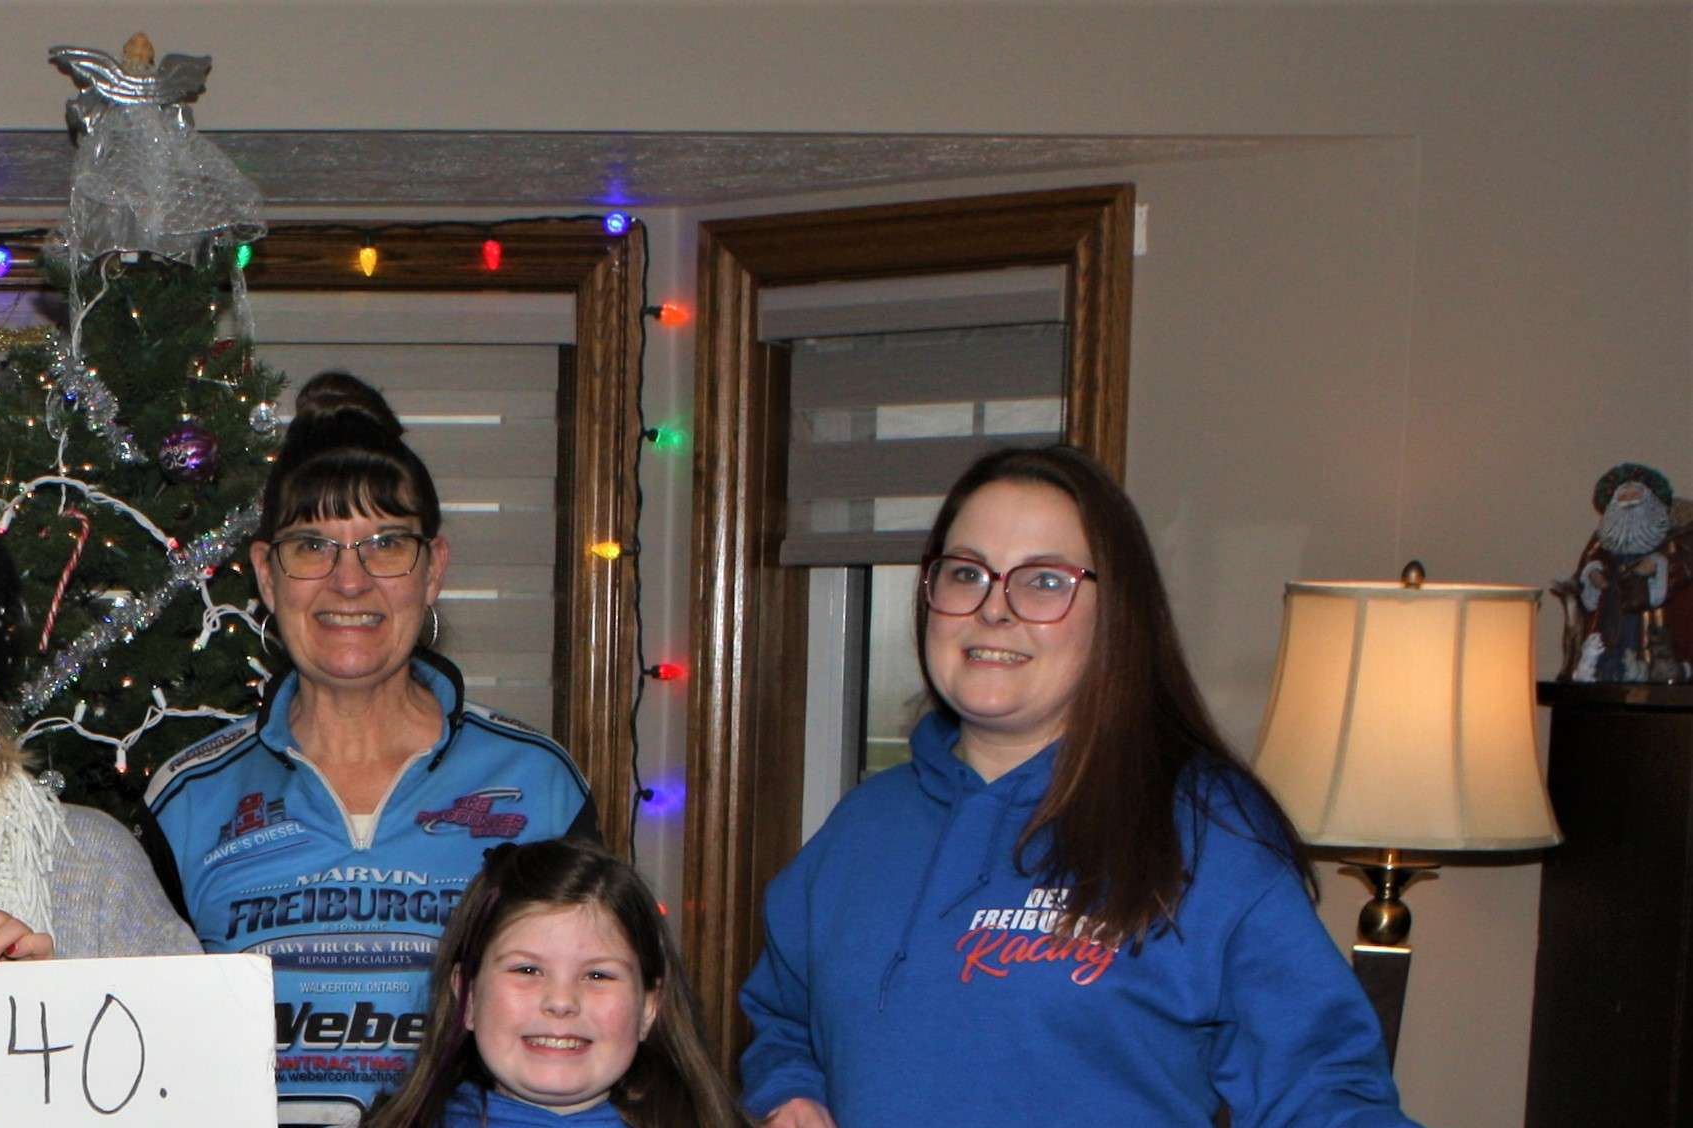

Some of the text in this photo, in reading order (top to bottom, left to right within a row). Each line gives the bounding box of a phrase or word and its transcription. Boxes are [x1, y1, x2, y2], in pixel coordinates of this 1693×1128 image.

[256, 822, 305, 850] DIESEL
[296, 866, 428, 886] MARVIN
[226, 887, 463, 940] FREIBURGE
[314, 941, 365, 954] TRUCK
[299, 954, 412, 965] REPAIR SPECIALISTS
[367, 981, 411, 994] ONTARIO
